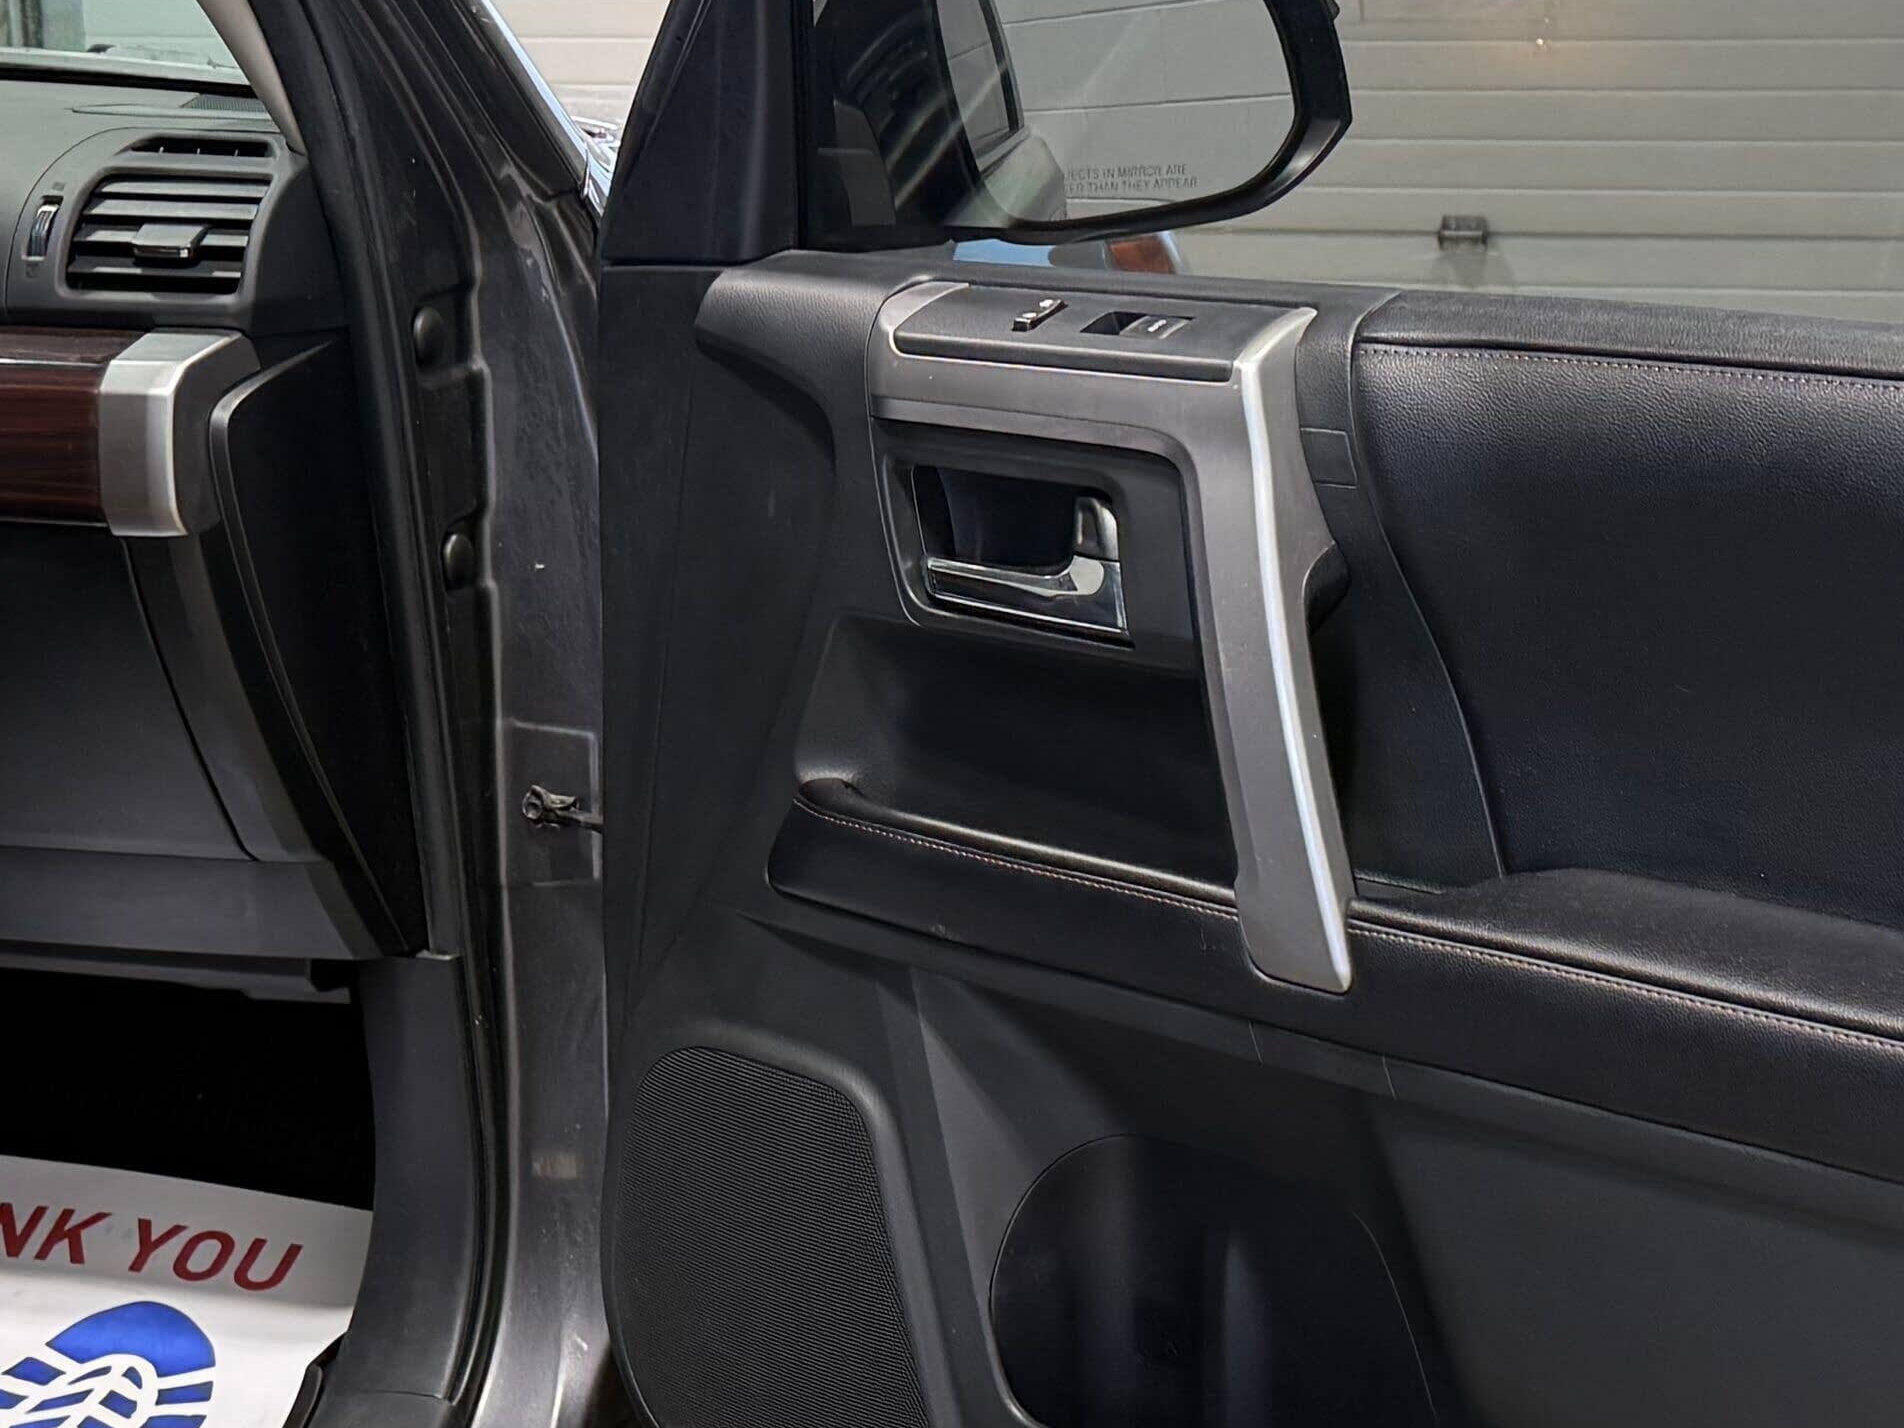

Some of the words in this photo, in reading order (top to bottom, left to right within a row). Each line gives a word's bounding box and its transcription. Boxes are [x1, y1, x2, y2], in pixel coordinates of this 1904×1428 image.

[1102, 166, 1115, 179] IN
[1117, 164, 1163, 178] MIRROR
[1165, 163, 1188, 176] ARE
[1088, 179, 1119, 193] THAN
[1122, 178, 1150, 192] THEY
[1152, 175, 1198, 189] APPEAR
[127, 1208, 303, 1292] YOU
